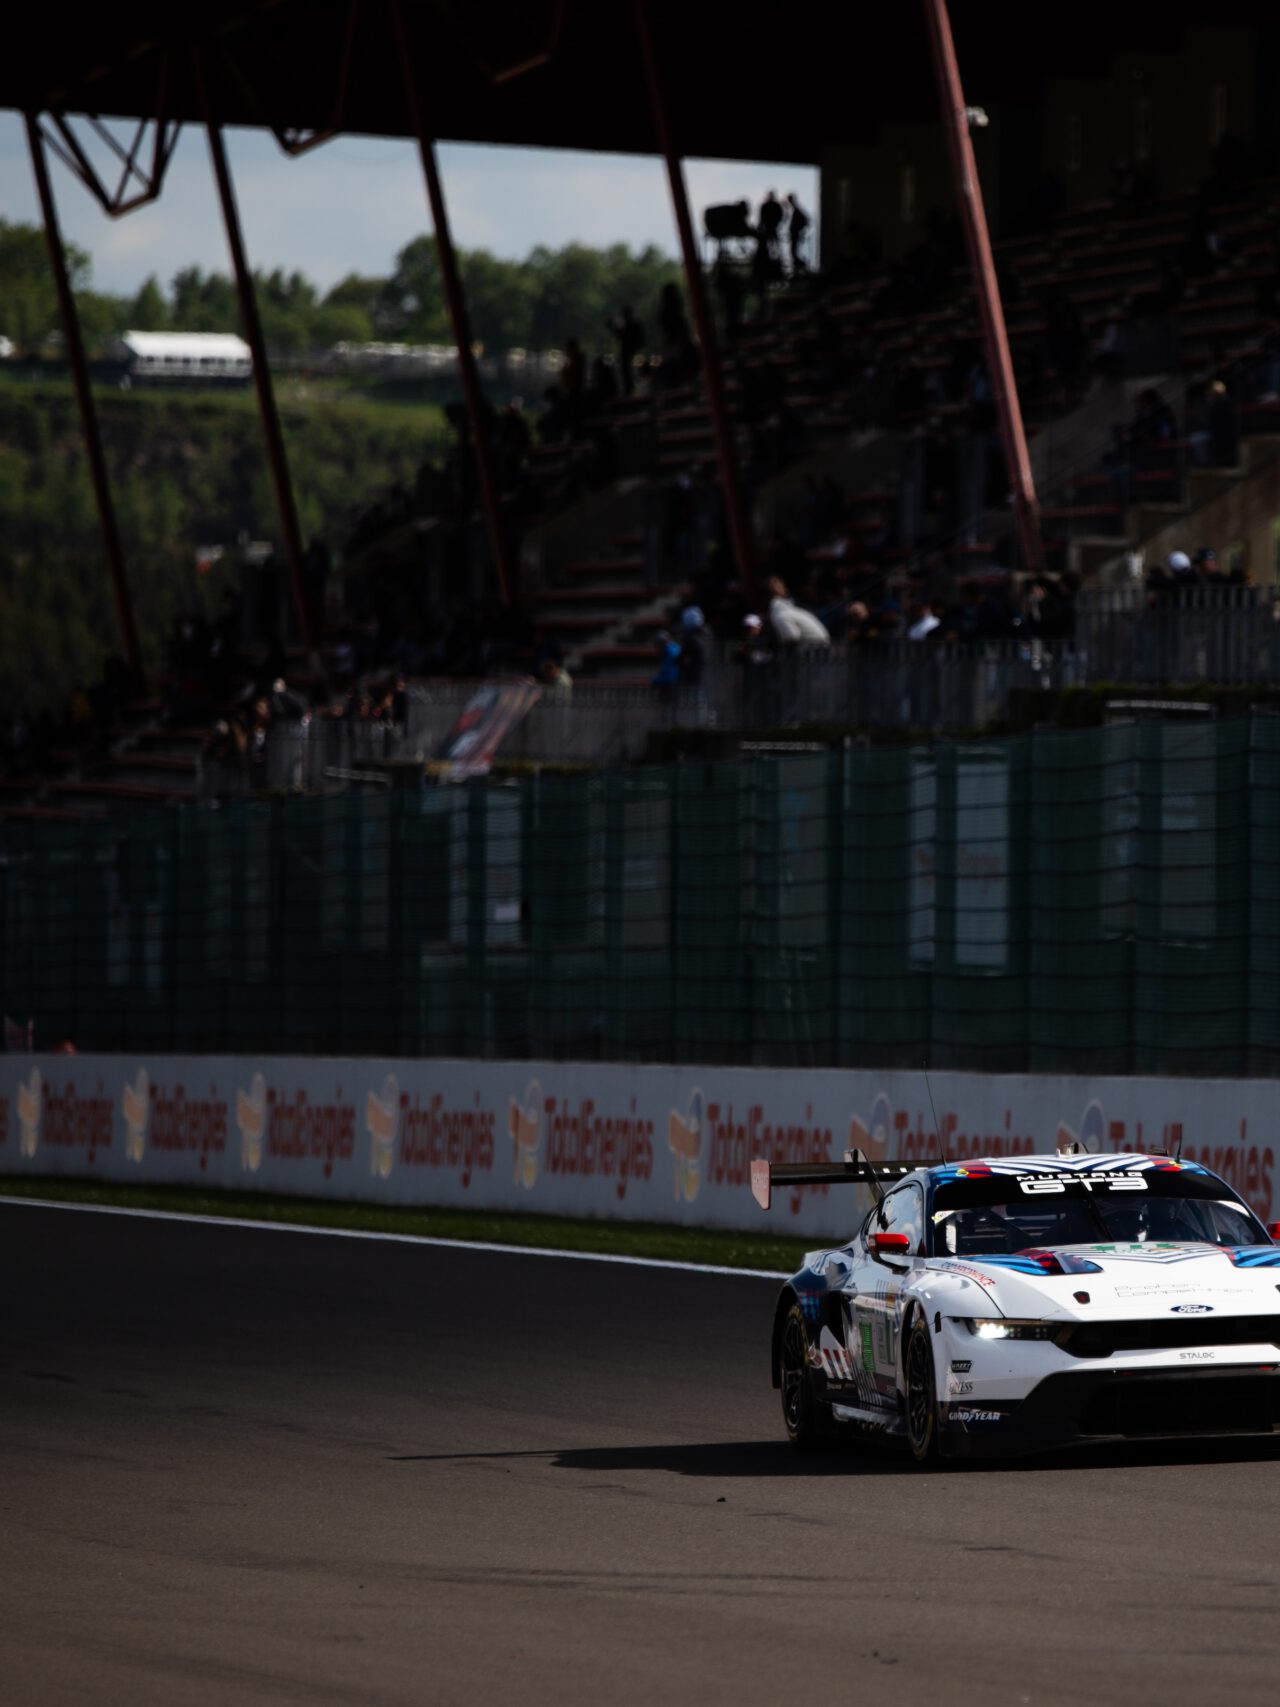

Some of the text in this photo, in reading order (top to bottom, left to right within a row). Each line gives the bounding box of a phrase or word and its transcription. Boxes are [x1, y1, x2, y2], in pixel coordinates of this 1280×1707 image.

[399, 1091, 496, 1189] TotalEnergies
[544, 1095, 654, 1200] TotalEnergies
[706, 1102, 833, 1214] TotalEnergies
[1016, 1171, 1143, 1181] MUSTANG
[1019, 1177, 1149, 1194] GT3
[1179, 1351, 1215, 1360] STALOC
[948, 1411, 1001, 1423] GOODYEAR
